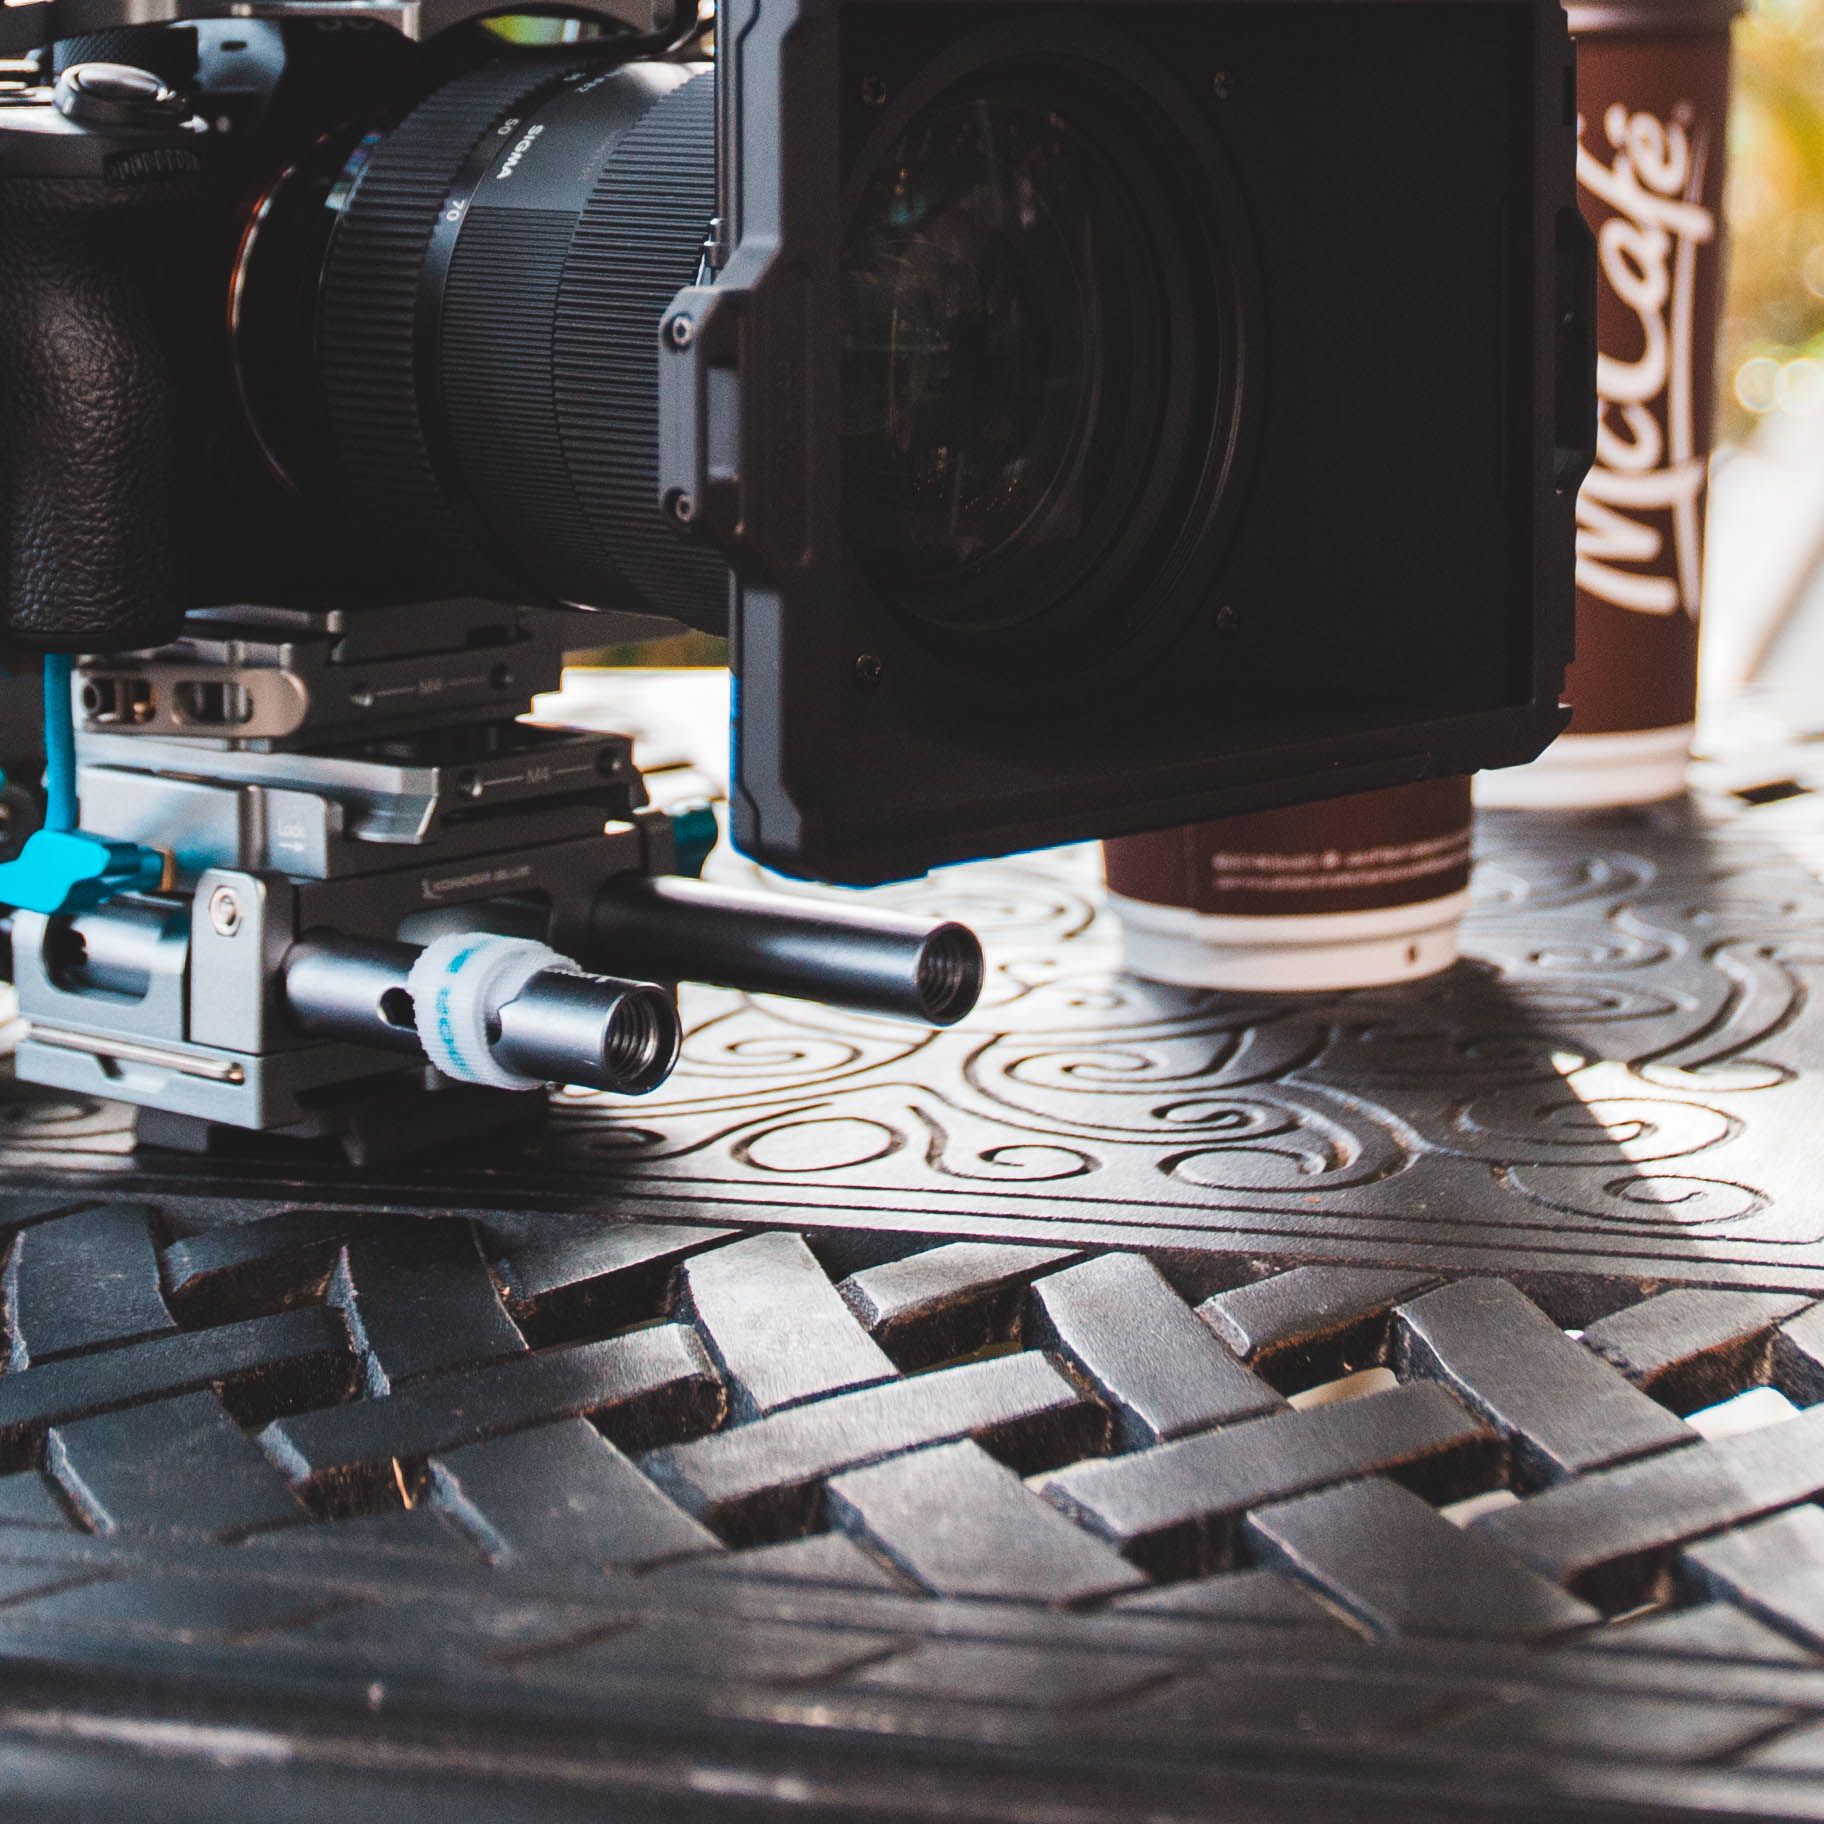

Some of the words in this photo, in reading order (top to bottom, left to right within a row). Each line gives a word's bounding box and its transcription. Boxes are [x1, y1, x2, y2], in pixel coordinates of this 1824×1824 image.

[495, 118, 521, 137] 50
[495, 122, 545, 180] SIGMA
[445, 198, 466, 222] 70
